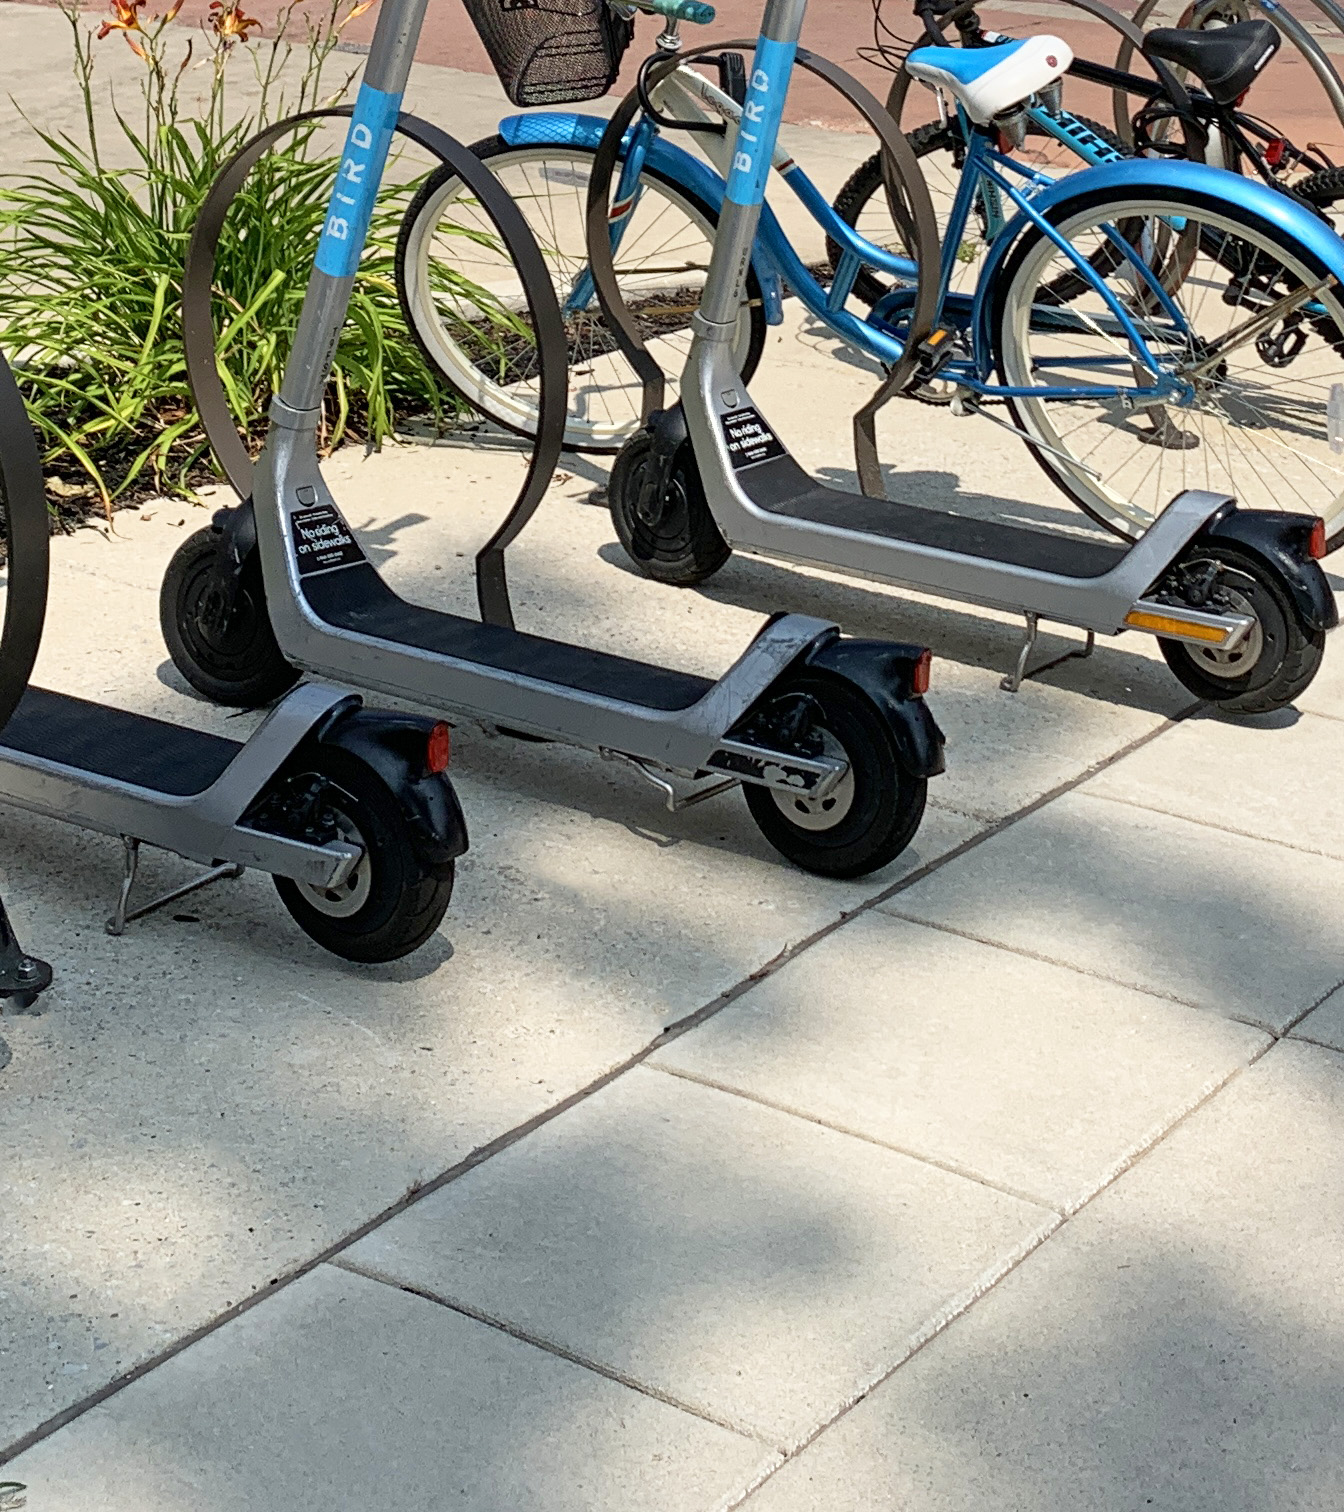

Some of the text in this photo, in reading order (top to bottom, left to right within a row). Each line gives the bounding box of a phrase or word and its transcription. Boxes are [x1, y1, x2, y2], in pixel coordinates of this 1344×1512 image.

[733, 68, 769, 174] BIRD
[325, 122, 373, 241] BIRD
[729, 423, 763, 439] No riding
[729, 432, 774, 452] on sidewalks
[300, 523, 340, 540] No riding
[298, 534, 352, 555] on sidewalks
